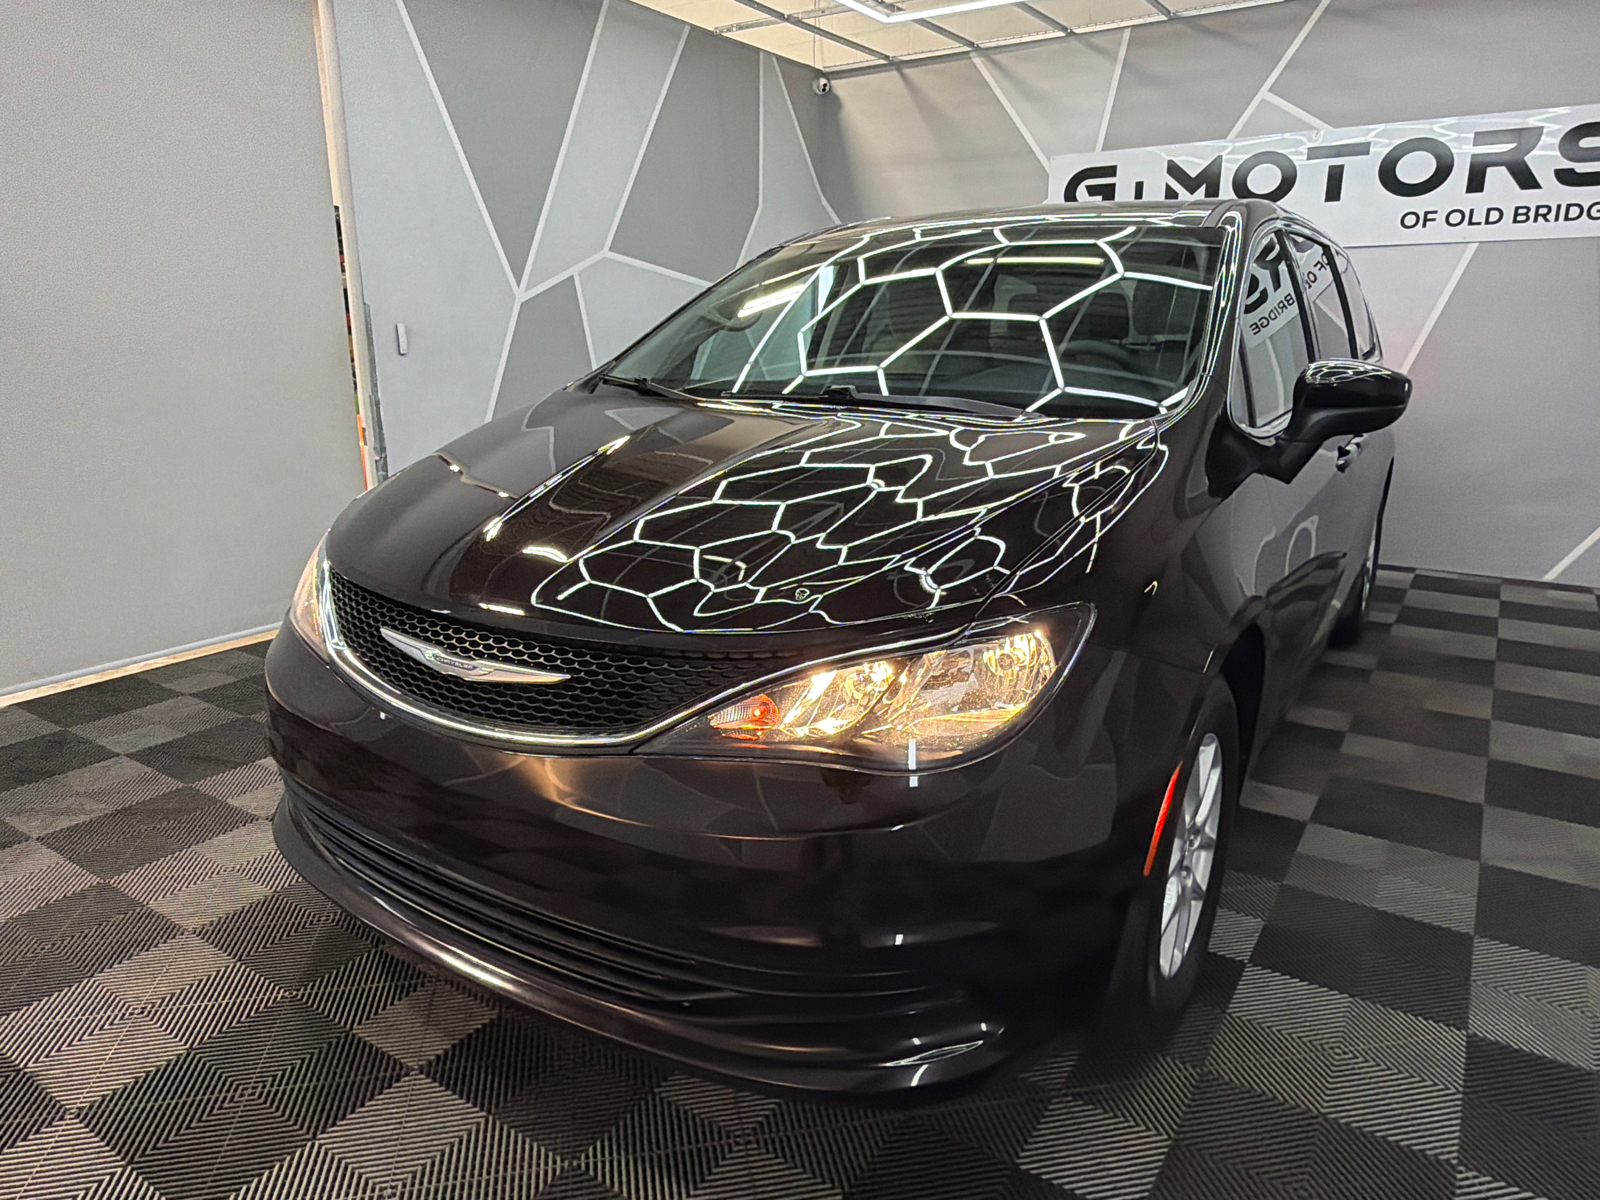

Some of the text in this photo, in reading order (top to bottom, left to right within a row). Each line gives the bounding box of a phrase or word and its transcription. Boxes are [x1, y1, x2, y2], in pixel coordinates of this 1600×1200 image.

[1164, 121, 1600, 203] MOTORS
[1399, 200, 1600, 229] OF OLD BRIDG
